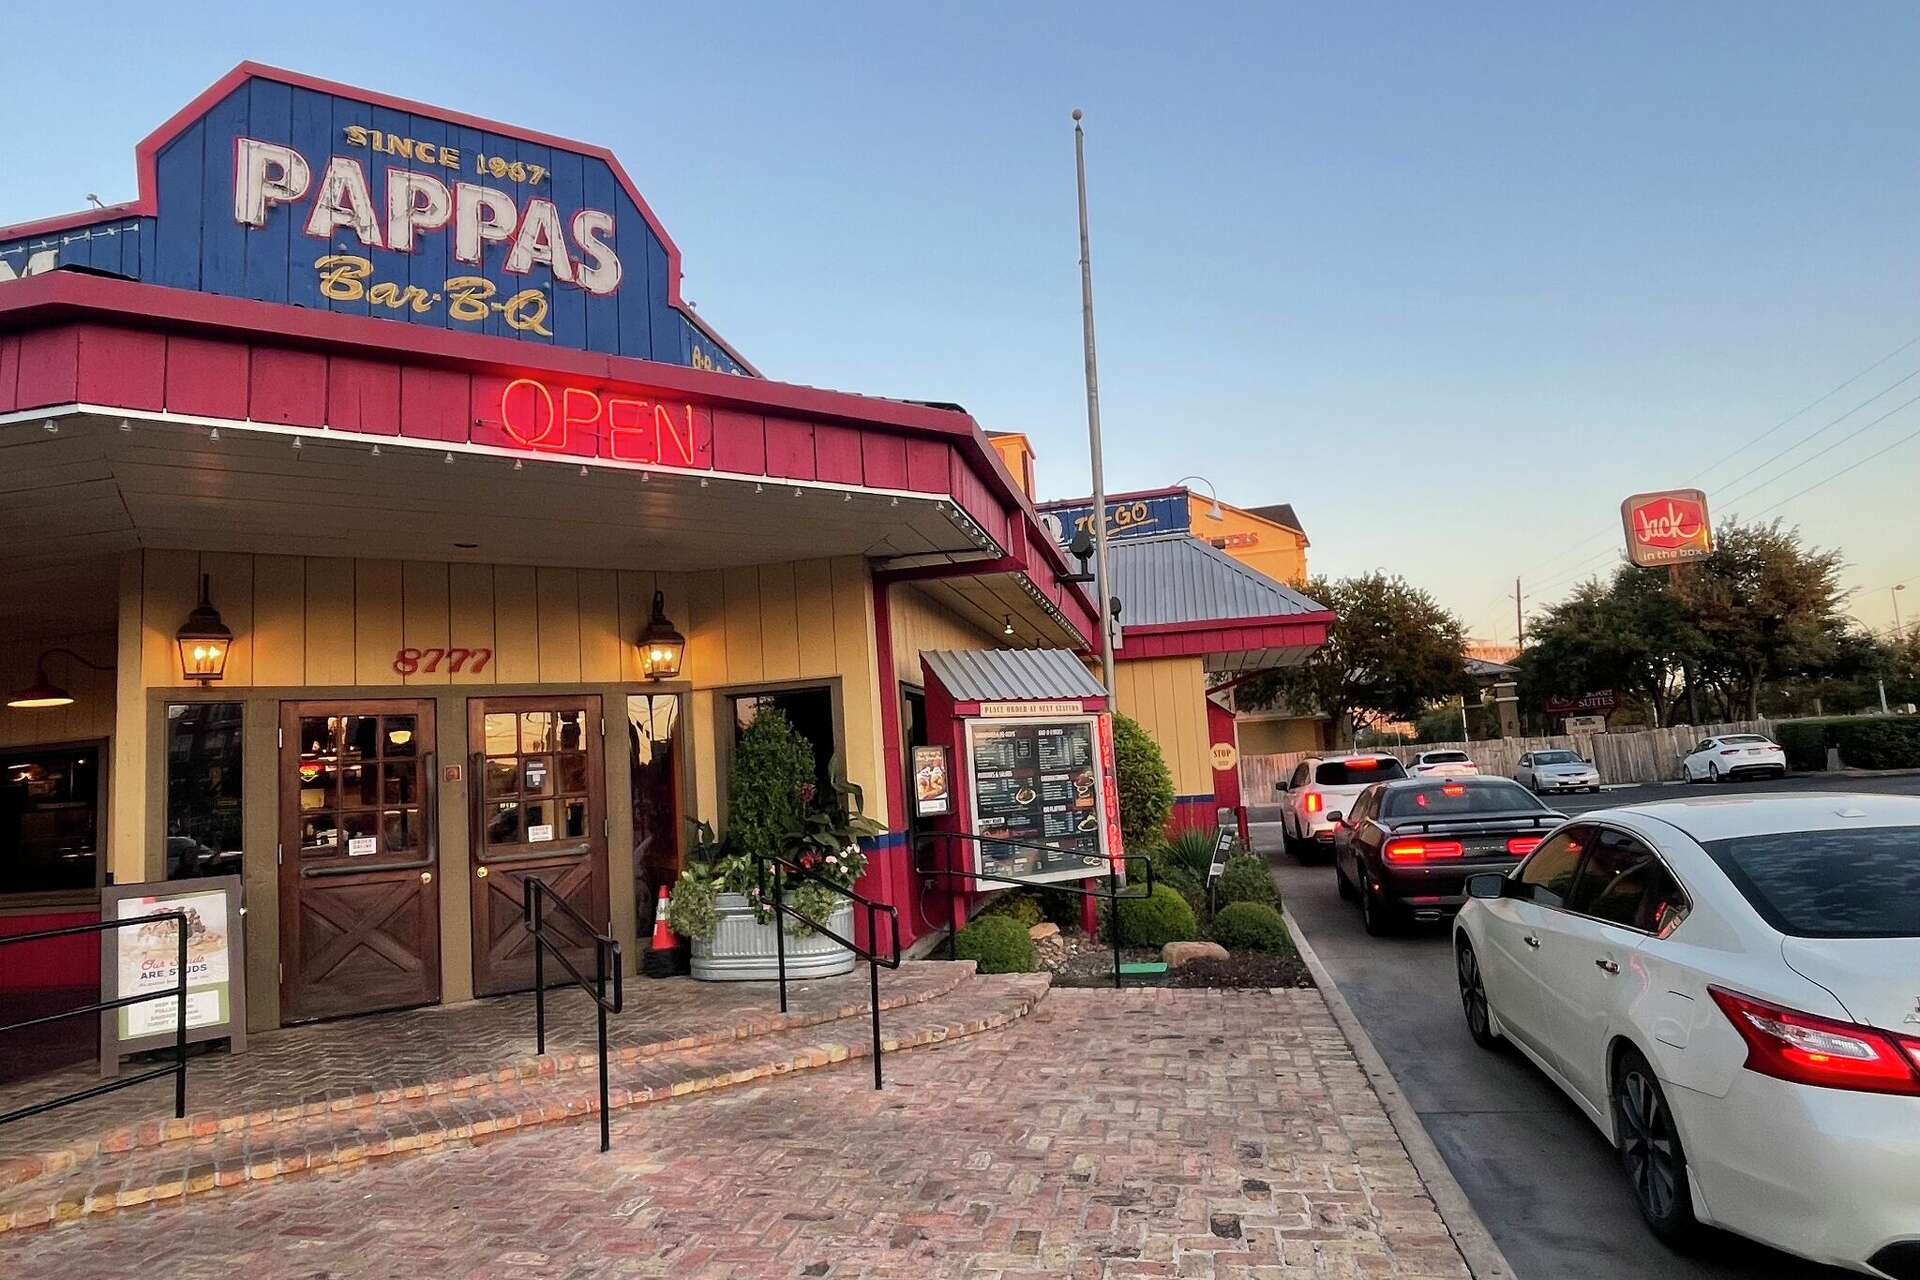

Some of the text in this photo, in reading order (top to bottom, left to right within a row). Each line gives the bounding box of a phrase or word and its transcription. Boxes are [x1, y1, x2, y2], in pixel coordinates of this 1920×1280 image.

[344, 125, 548, 185] SINCE 1967
[234, 137, 622, 295] PAPPAS
[501, 378, 694, 465] OPEN
[1638, 502, 1701, 542] Jack
[1643, 548, 1703, 561] in the box
[393, 647, 492, 675] 8777
[1006, 705, 1028, 713] ORDER
[1578, 697, 1615, 707] SUITES
[1213, 749, 1231, 758] STOP
[140, 970, 164, 979] ARE
